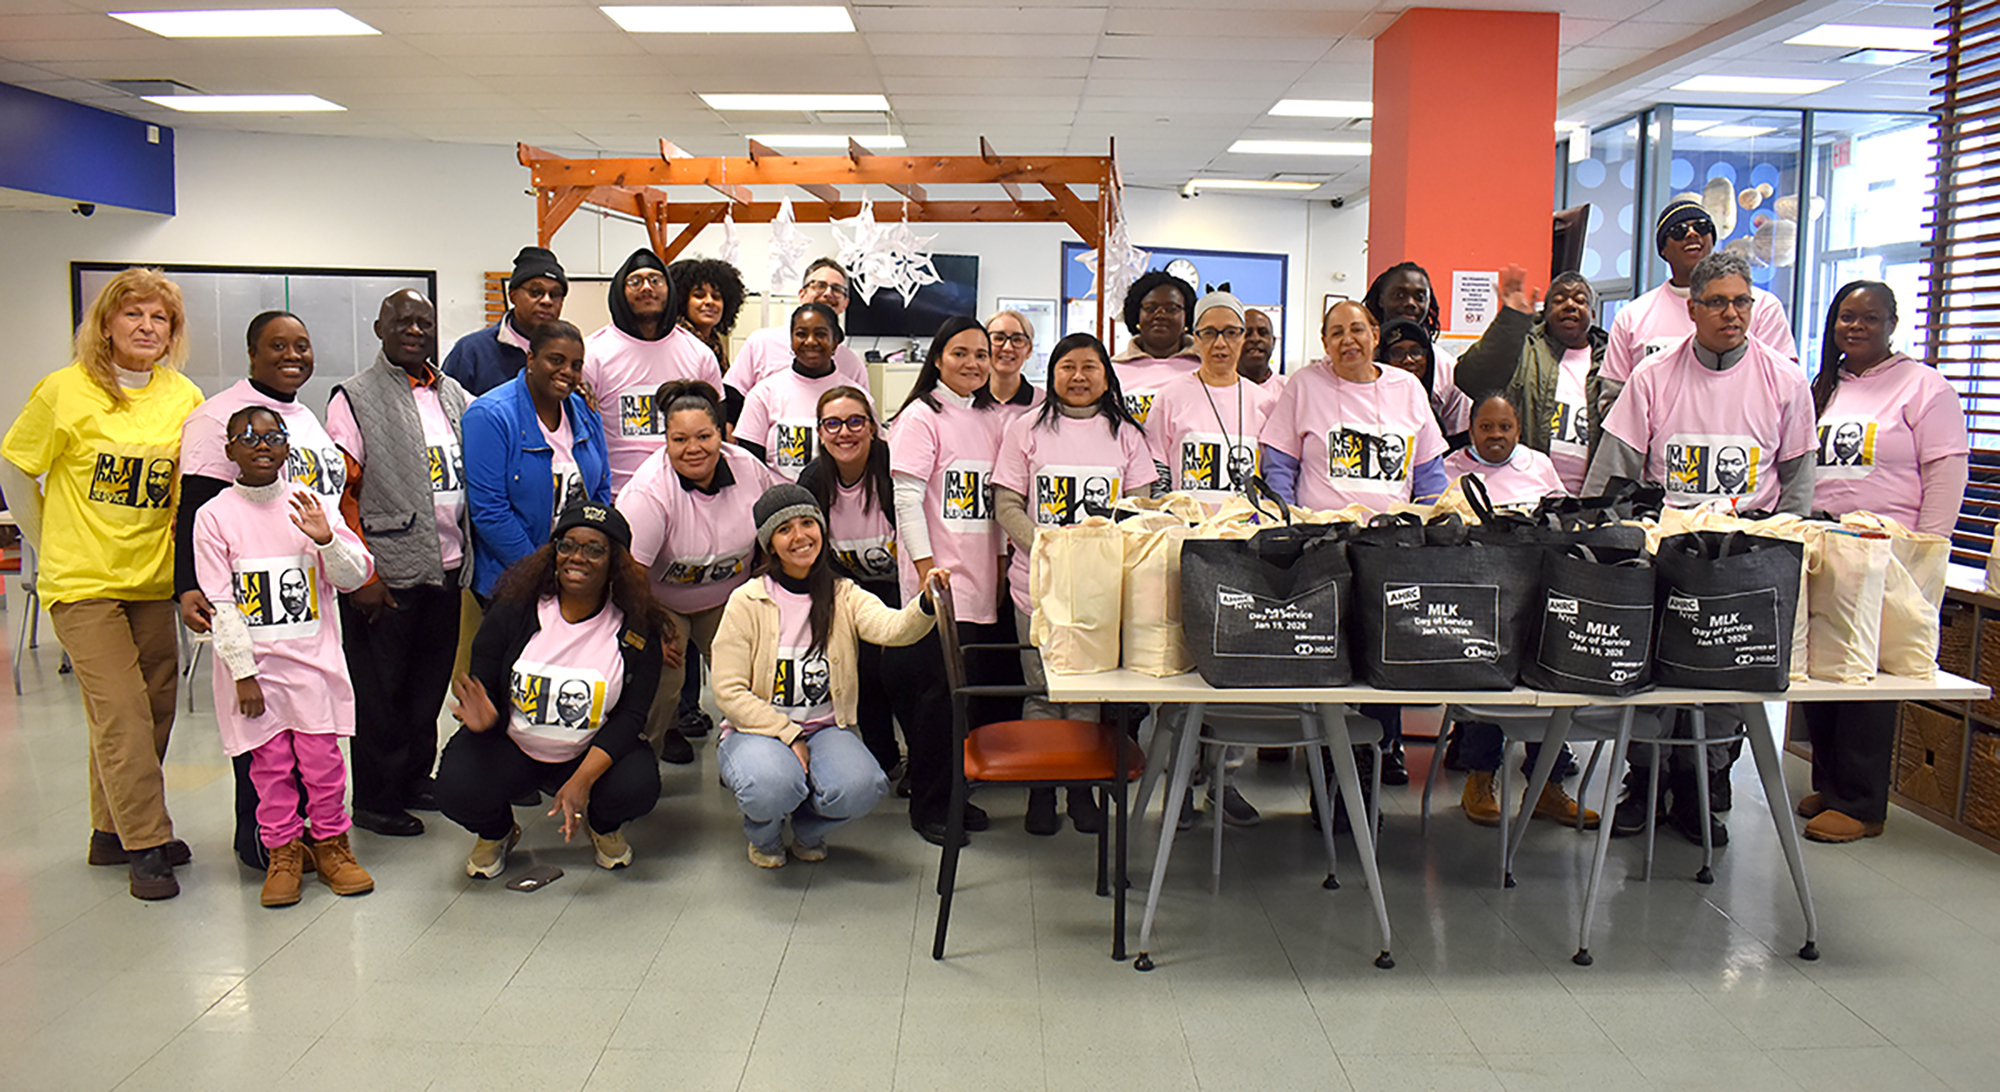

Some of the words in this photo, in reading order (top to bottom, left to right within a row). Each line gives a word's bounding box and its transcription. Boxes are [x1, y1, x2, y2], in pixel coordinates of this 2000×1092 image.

[1390, 588, 1418, 603] AHRC
[1402, 602, 1420, 611] NYC
[1428, 604, 1459, 616] MLK
[1550, 600, 1576, 612] AHRC
[1413, 617, 1431, 627] Day
[1443, 617, 1474, 627] Service
[1557, 612, 1578, 626] NYC
[1678, 610, 1699, 623] NYC
[1709, 612, 1741, 628] MLK
[1254, 621, 1271, 630] Jan
[1286, 621, 1308, 631] 2026
[1586, 621, 1621, 637] MLK
[1691, 626, 1712, 639] Day
[1722, 622, 1754, 635] Service
[1567, 629, 1588, 645] Day
[1588, 635, 1601, 646] of
[1601, 637, 1632, 648] Service
[1727, 633, 1748, 644] 2026
[1571, 642, 1588, 653] Jan
[1604, 647, 1624, 658] 2026
